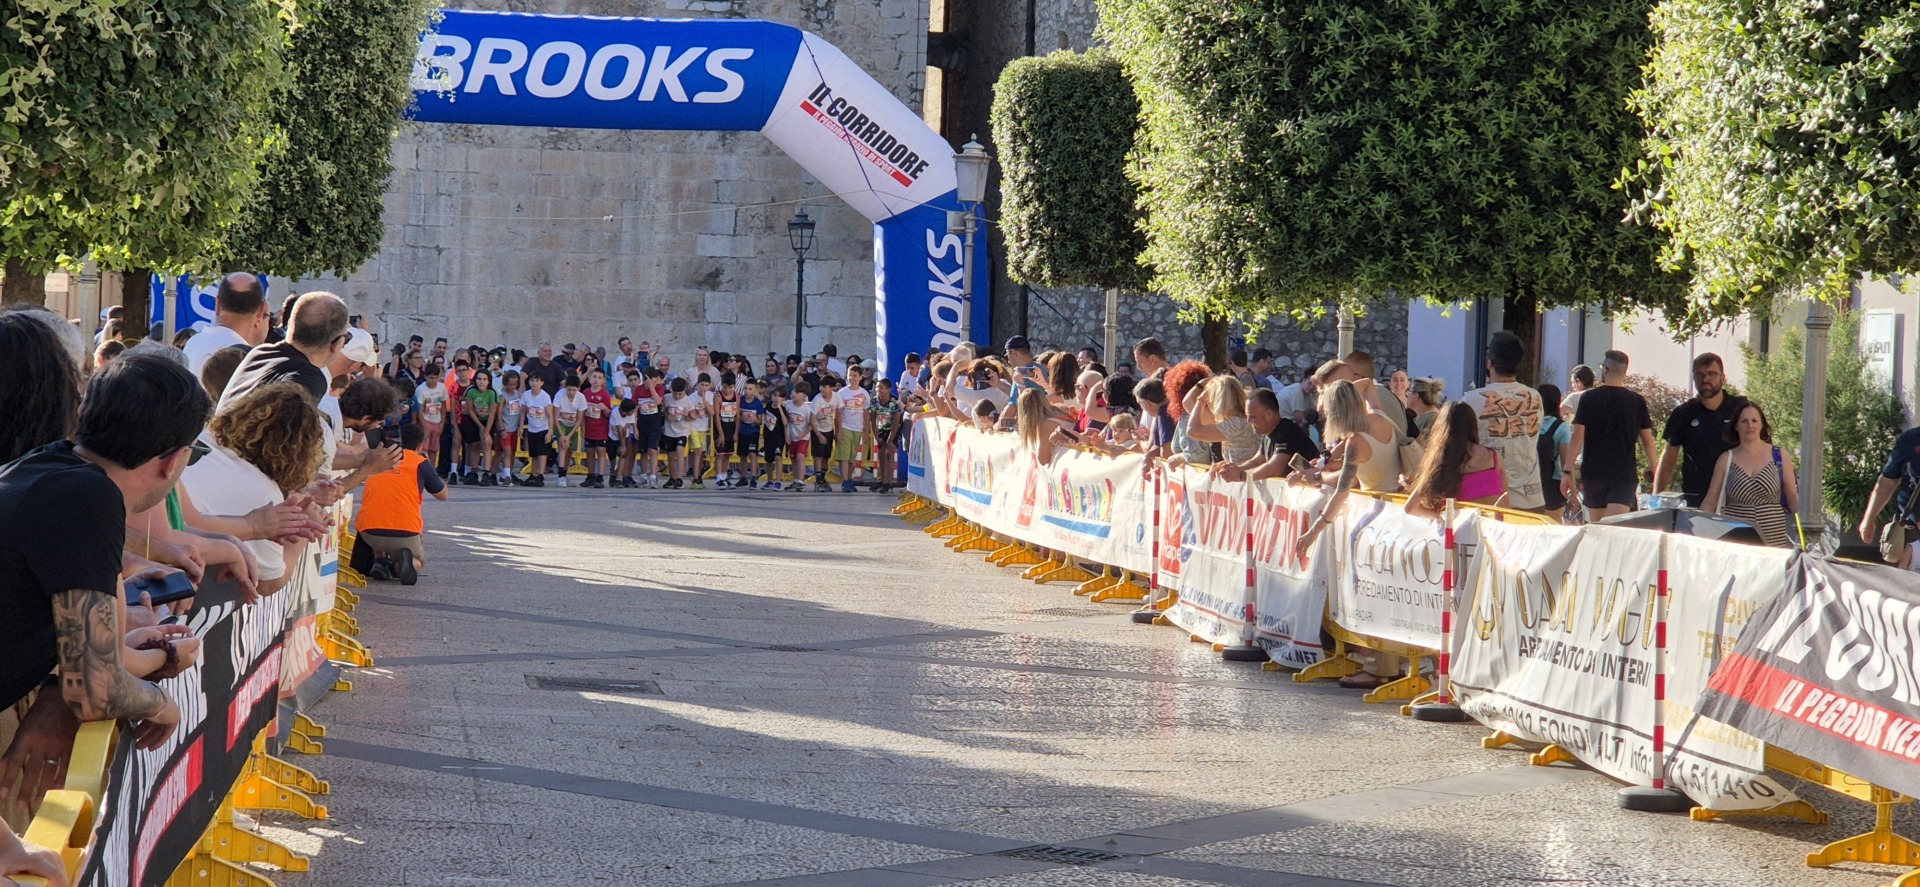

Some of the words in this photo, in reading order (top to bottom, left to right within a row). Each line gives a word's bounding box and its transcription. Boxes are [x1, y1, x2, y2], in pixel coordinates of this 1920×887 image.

[411, 34, 754, 103] BROOKS
[808, 82, 832, 107] IL
[827, 97, 929, 180] CORRIDORE
[819, 115, 846, 139] PEGGIOR
[874, 158, 897, 175] SPORT
[1162, 538, 1181, 566] Hape
[1355, 578, 1412, 605] RREDAMENTO
[1413, 589, 1423, 606] DI
[1590, 576, 1673, 653] VOGU
[1757, 567, 1836, 664] IL
[1582, 649, 1597, 674] DI
[1601, 653, 1652, 688] INTERNI
[1539, 715, 1592, 754] FONDI
[1774, 680, 1805, 714] IL
[1795, 688, 1888, 747] PEGGIOR
